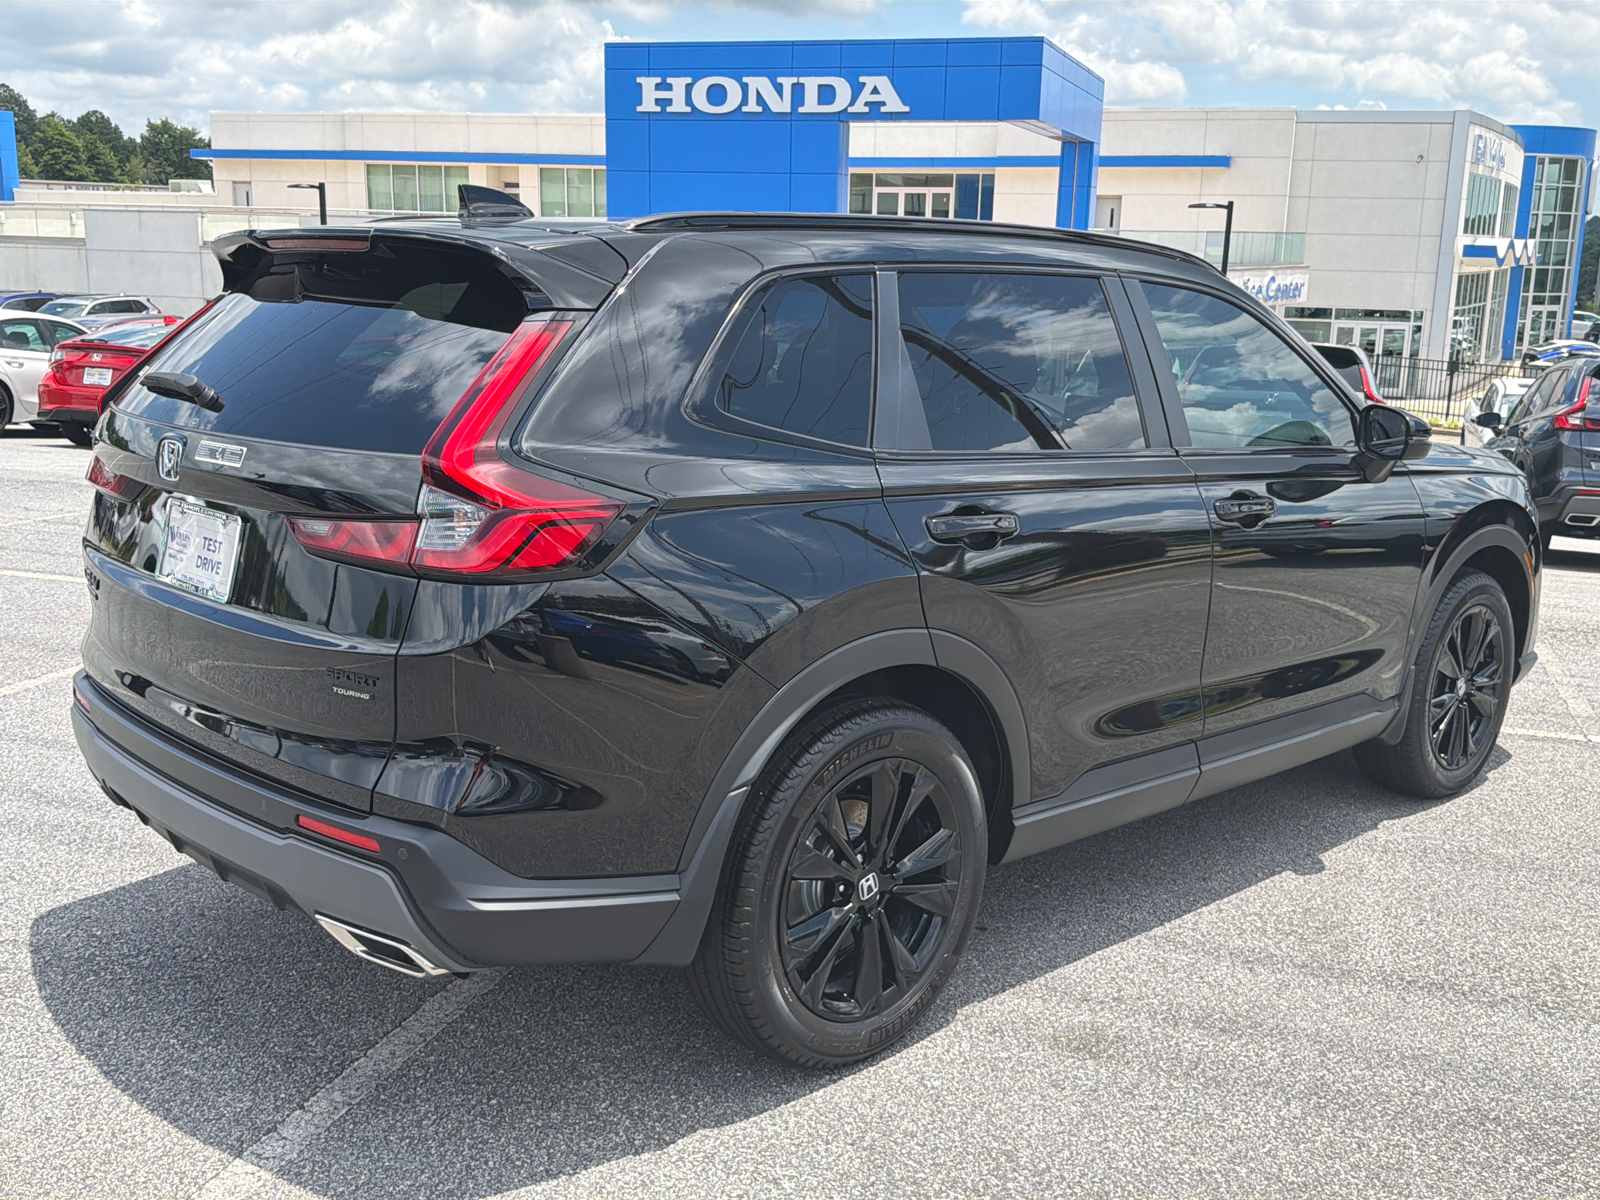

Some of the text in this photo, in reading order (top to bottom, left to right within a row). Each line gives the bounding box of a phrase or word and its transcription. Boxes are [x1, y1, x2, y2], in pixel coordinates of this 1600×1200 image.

[636, 76, 910, 114] HONDA
[1265, 276, 1305, 301] Center
[202, 536, 223, 554] TEST
[195, 555, 222, 575] DRIVE
[326, 667, 380, 687] SPORT
[332, 686, 370, 700] TOURING
[822, 733, 893, 786] MICHELIN
[871, 986, 933, 1045] MICHELIN
